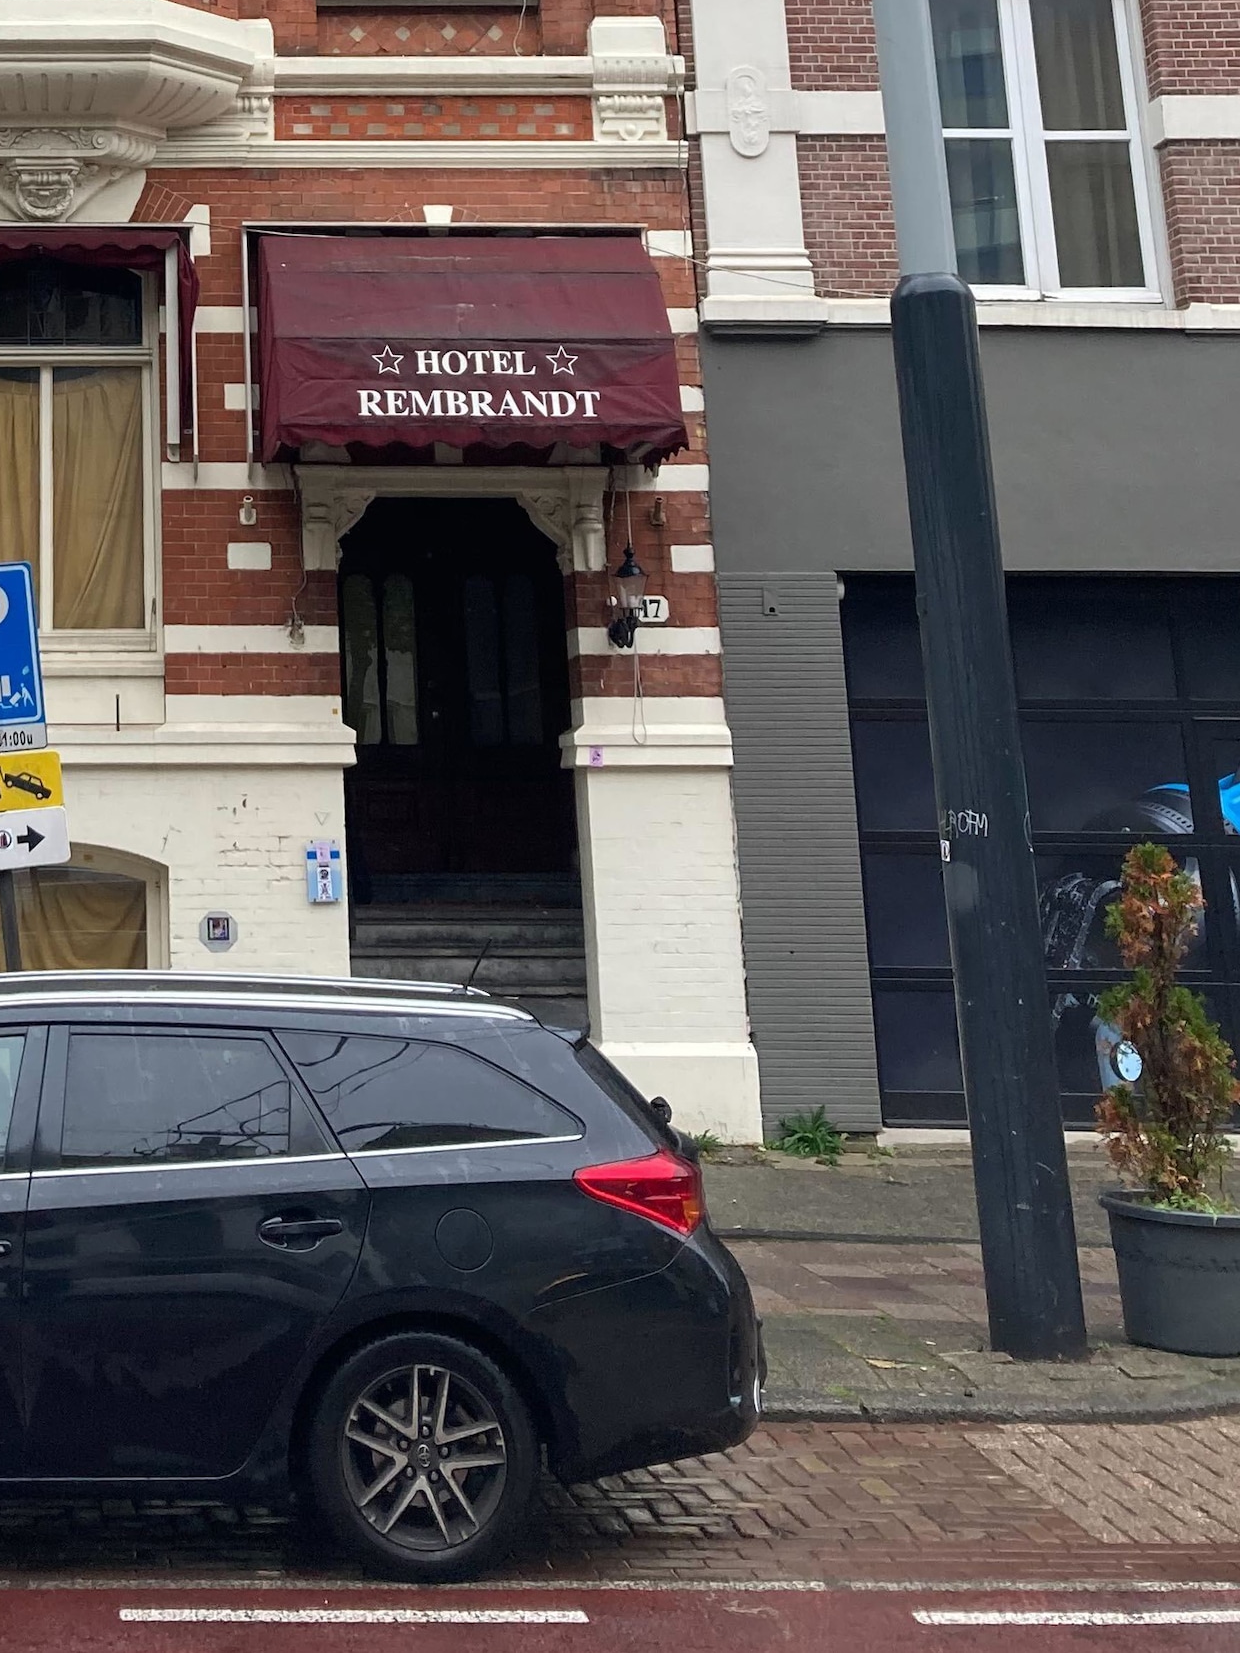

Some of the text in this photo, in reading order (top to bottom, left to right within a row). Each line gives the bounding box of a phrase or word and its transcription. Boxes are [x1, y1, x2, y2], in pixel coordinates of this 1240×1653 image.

[414, 350, 537, 376] HOTEL
[357, 389, 601, 418] REMBRANDT
[641, 599, 661, 618] 17
